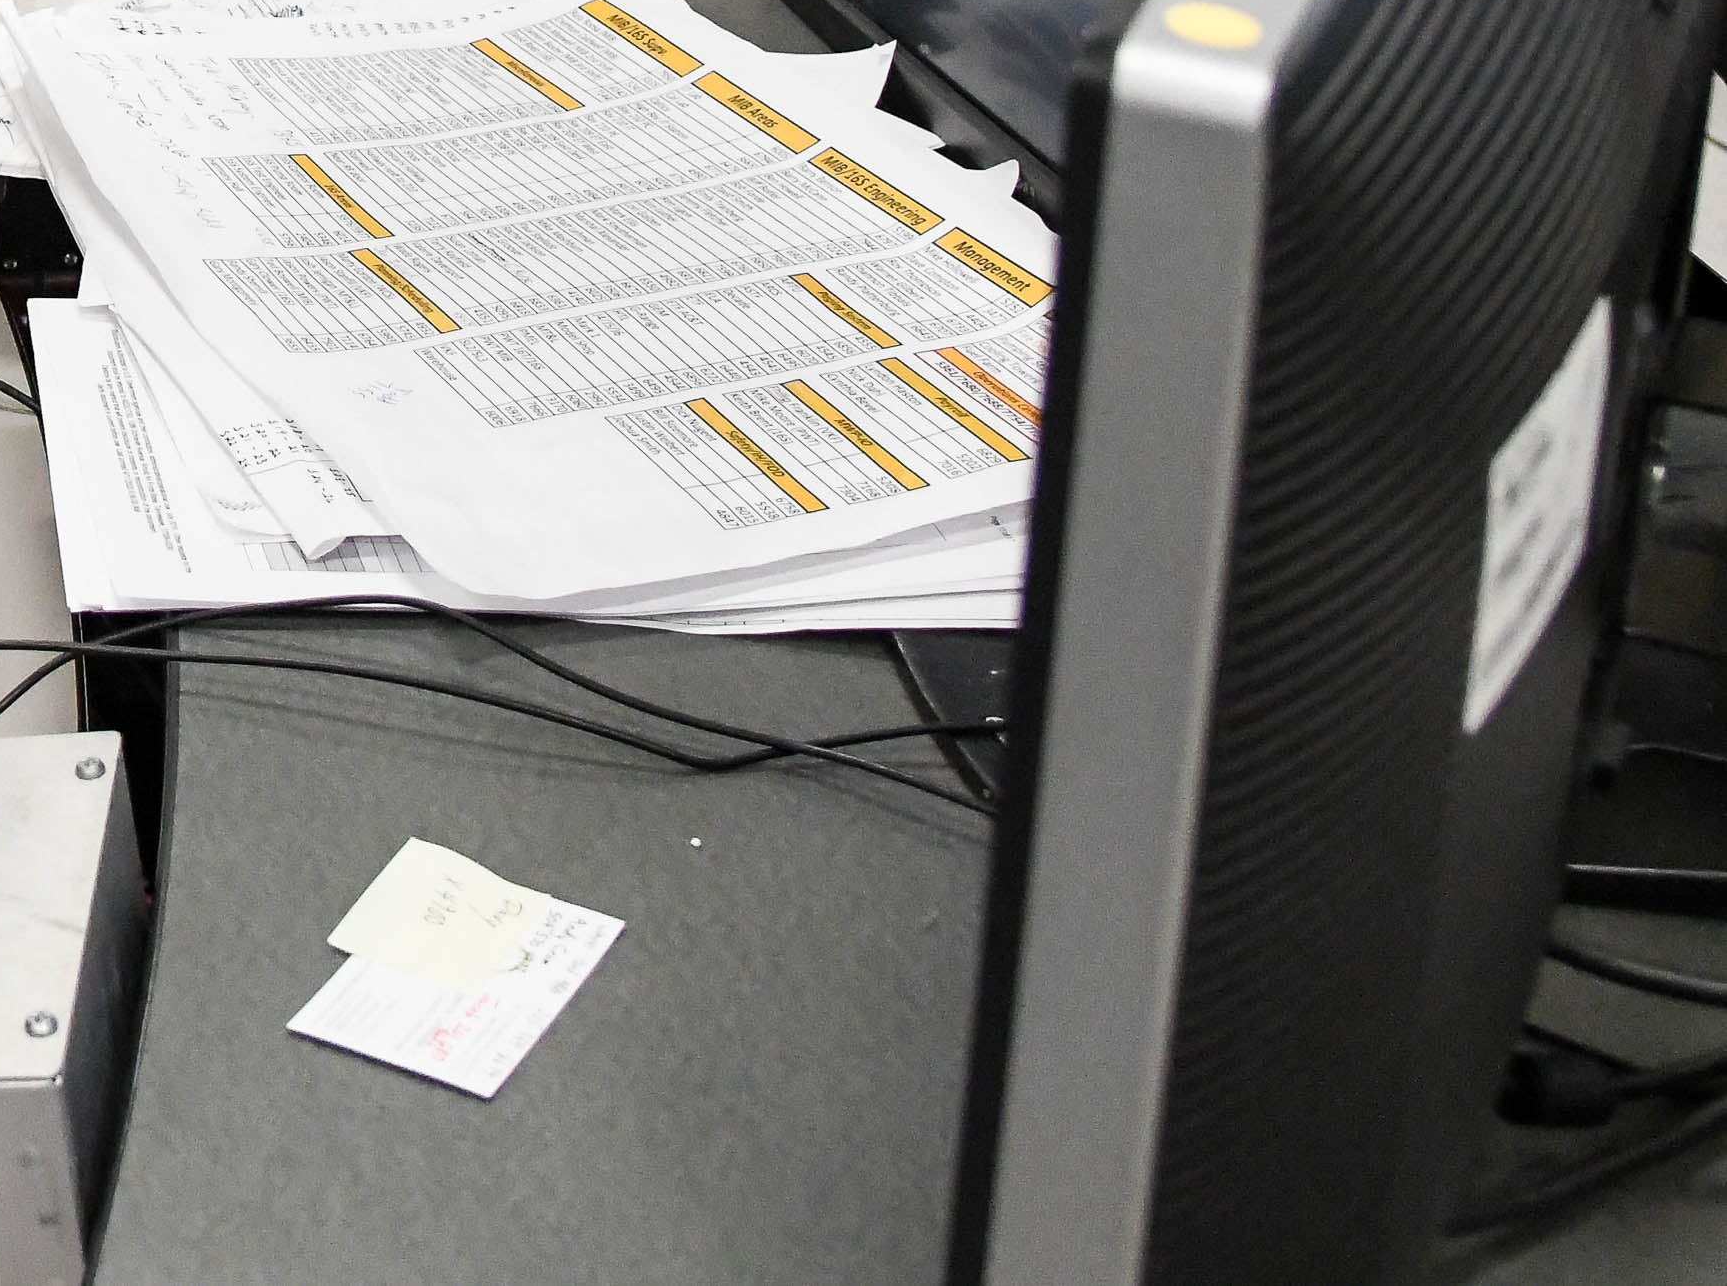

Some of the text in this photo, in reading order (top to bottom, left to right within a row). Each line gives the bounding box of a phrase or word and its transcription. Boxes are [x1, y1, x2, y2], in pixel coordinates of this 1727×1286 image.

[724, 94, 784, 128] MIB Areas
[815, 155, 931, 226] MIB/16S Engineering
[947, 240, 1034, 293] Management
